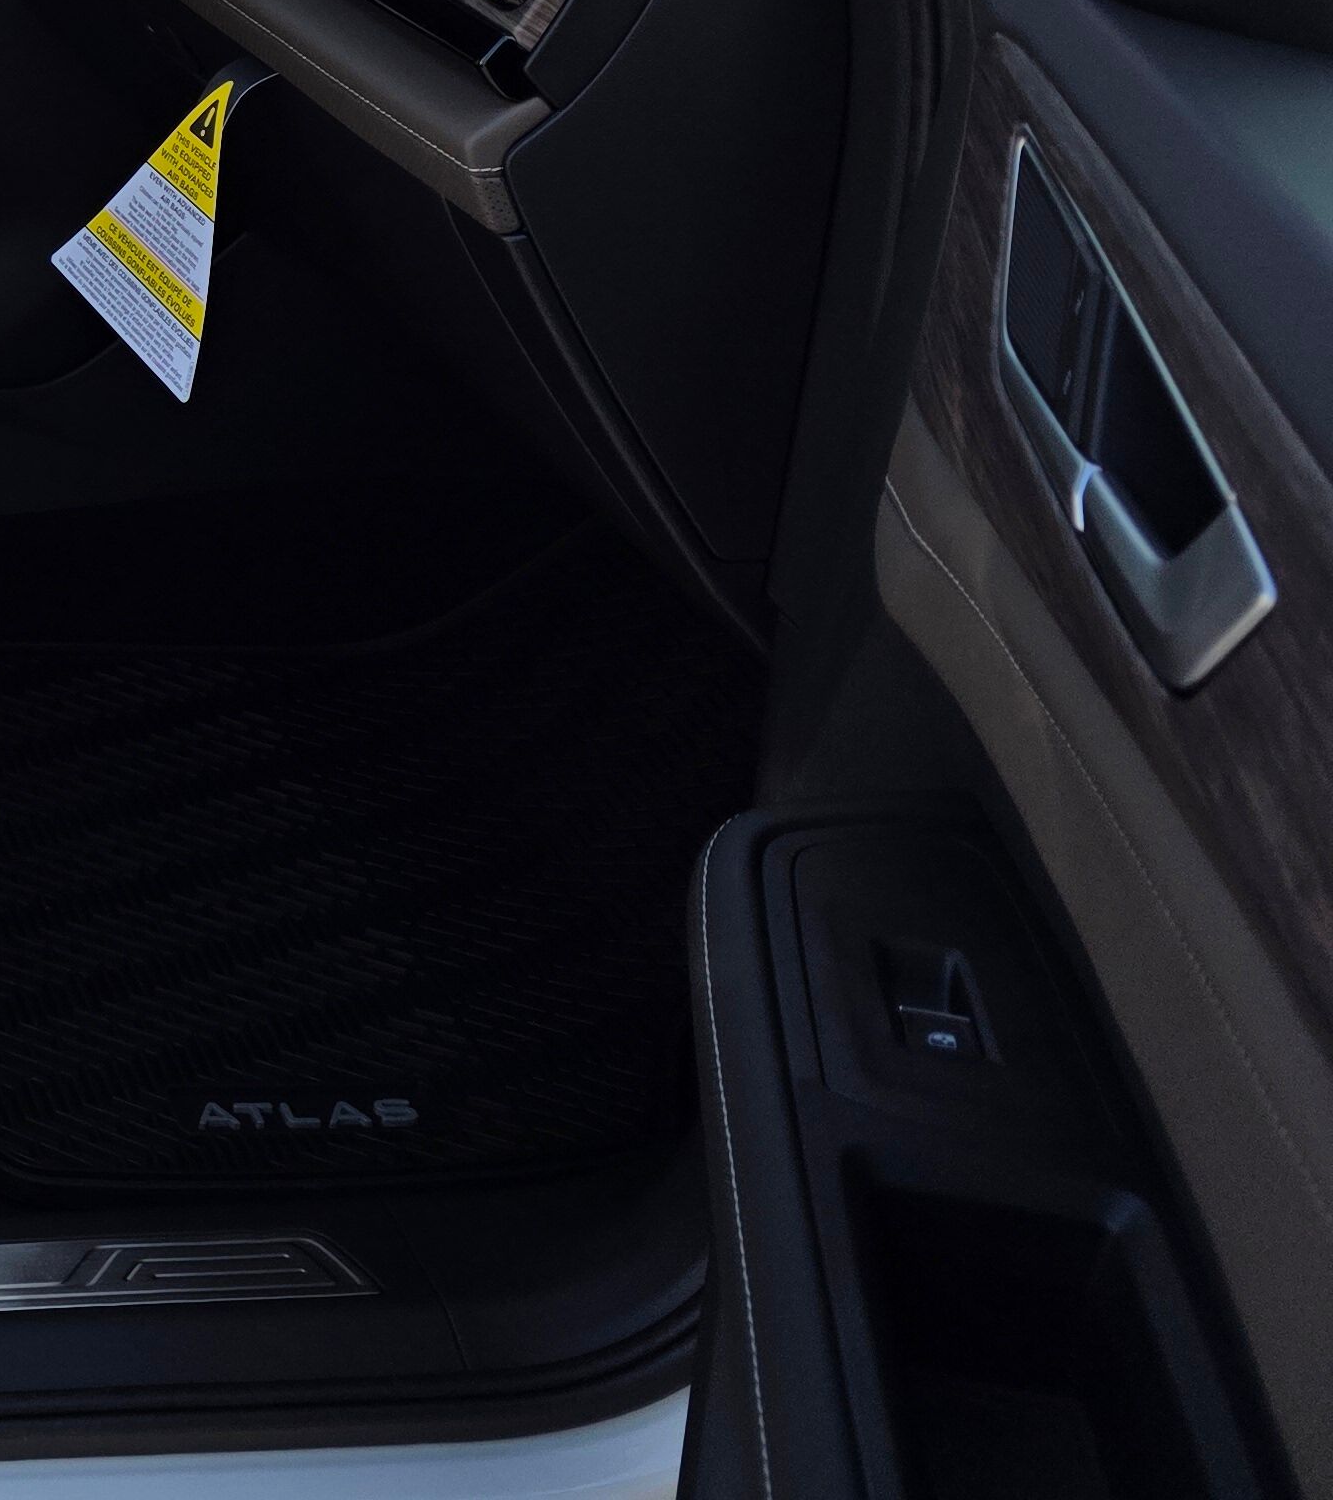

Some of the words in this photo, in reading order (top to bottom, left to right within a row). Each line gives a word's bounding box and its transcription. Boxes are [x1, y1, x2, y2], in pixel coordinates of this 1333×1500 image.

[170, 142, 181, 153] IS
[178, 149, 213, 181] EQUIPPED
[175, 130, 192, 149] THIS
[188, 143, 218, 171] VEHICLE
[160, 147, 179, 167] WITH
[177, 164, 215, 199] ADVANCED
[165, 168, 181, 183] AIR
[178, 179, 200, 201] BAGS
[107, 222, 119, 235] CE
[144, 259, 160, 275] EST
[181, 295, 193, 308] DE
[198, 1099, 419, 1130] ATLAS
